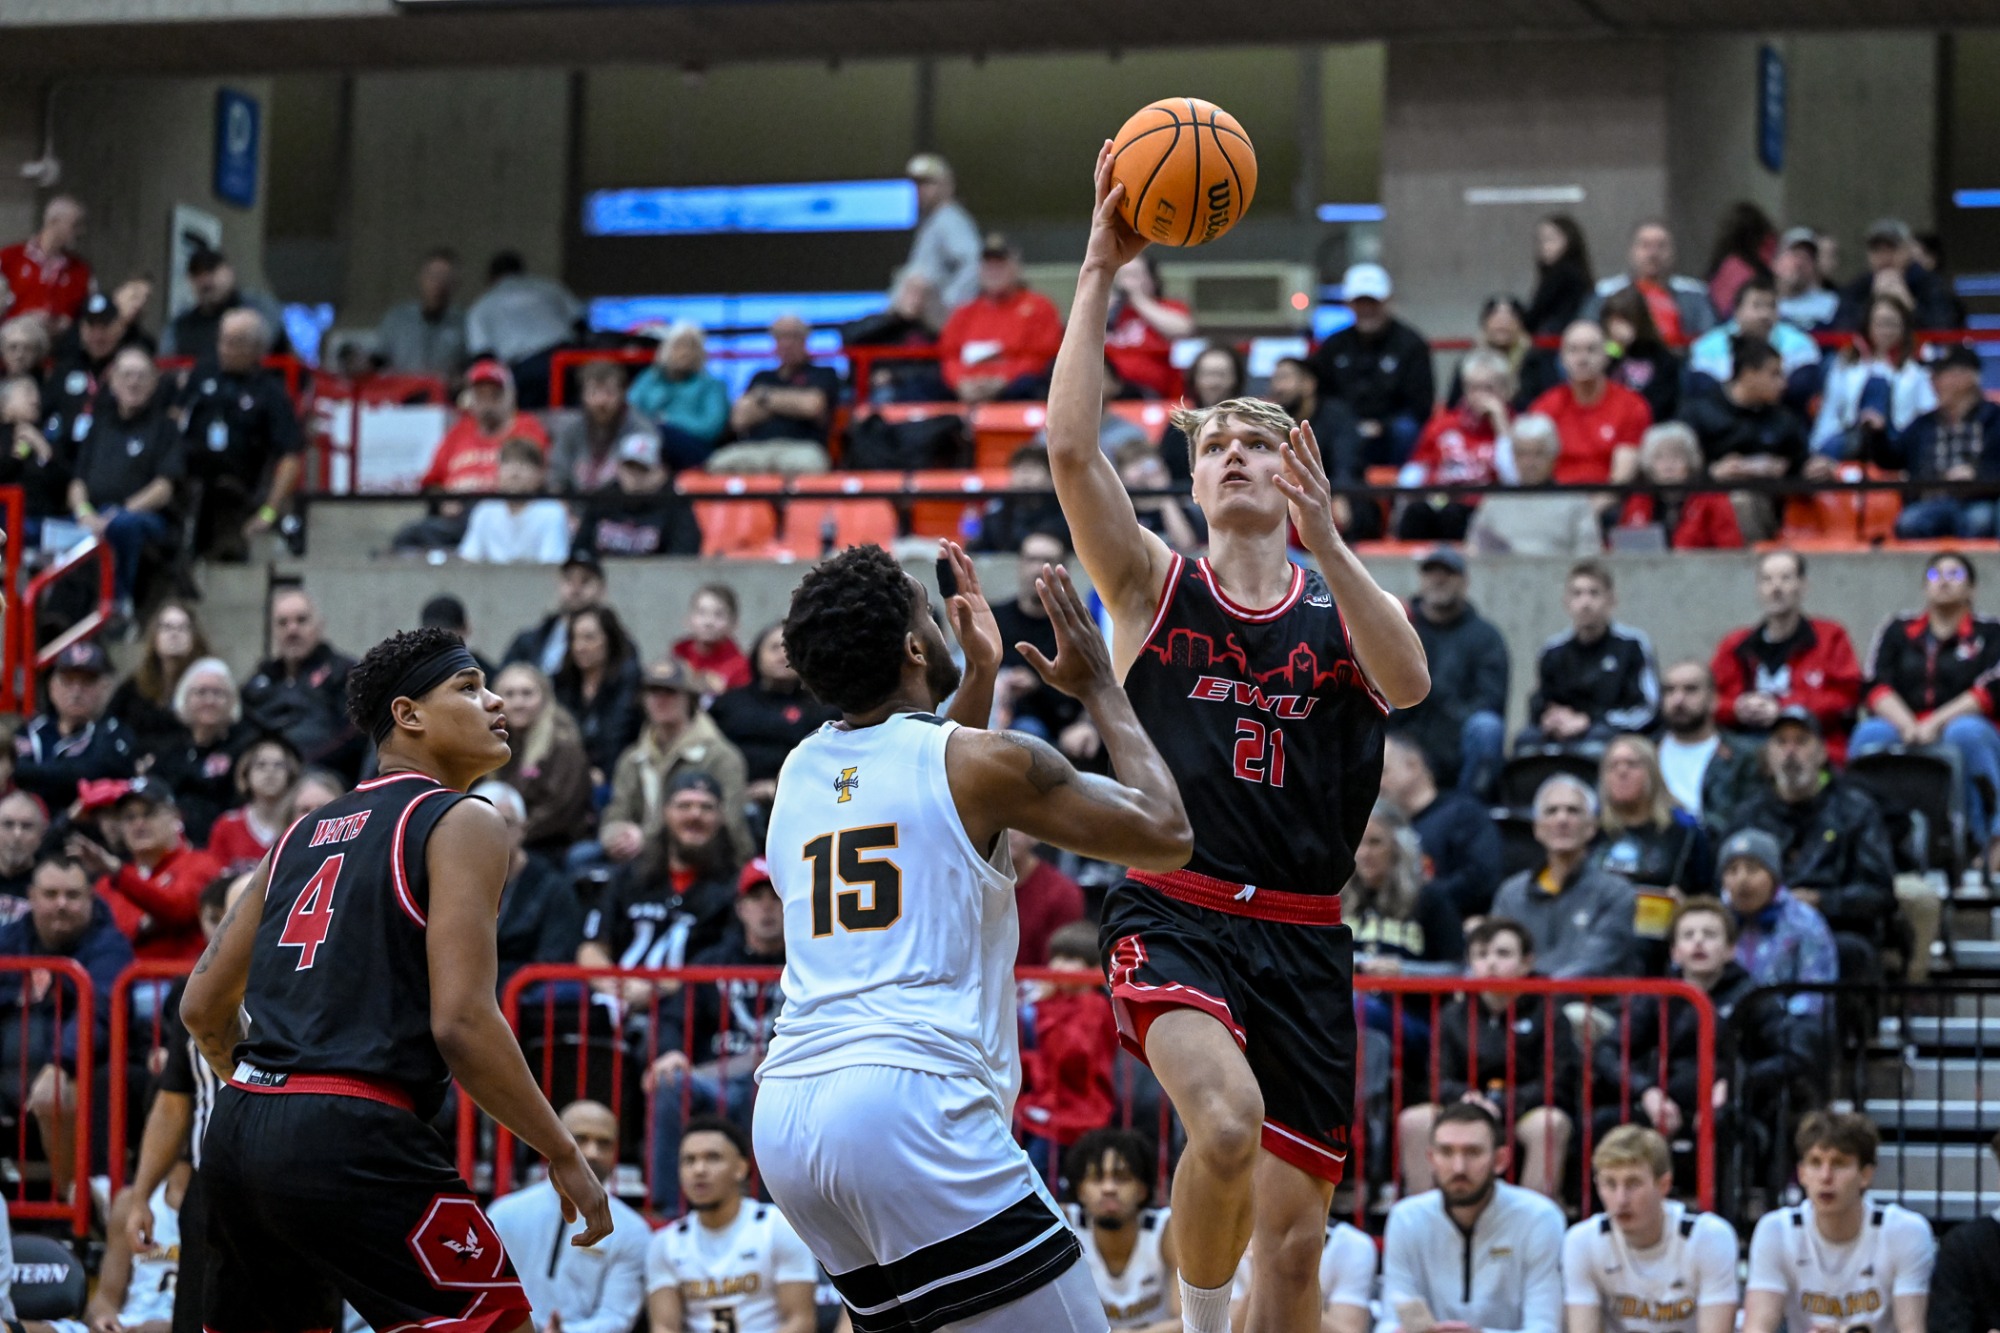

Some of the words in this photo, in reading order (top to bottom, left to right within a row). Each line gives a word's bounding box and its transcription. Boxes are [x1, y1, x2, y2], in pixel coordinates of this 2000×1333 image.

[1187, 675, 1320, 719] EWU
[1233, 717, 1286, 788] 21
[308, 809, 372, 848] WATTS
[277, 852, 345, 972] 4
[802, 822, 902, 939] 15
